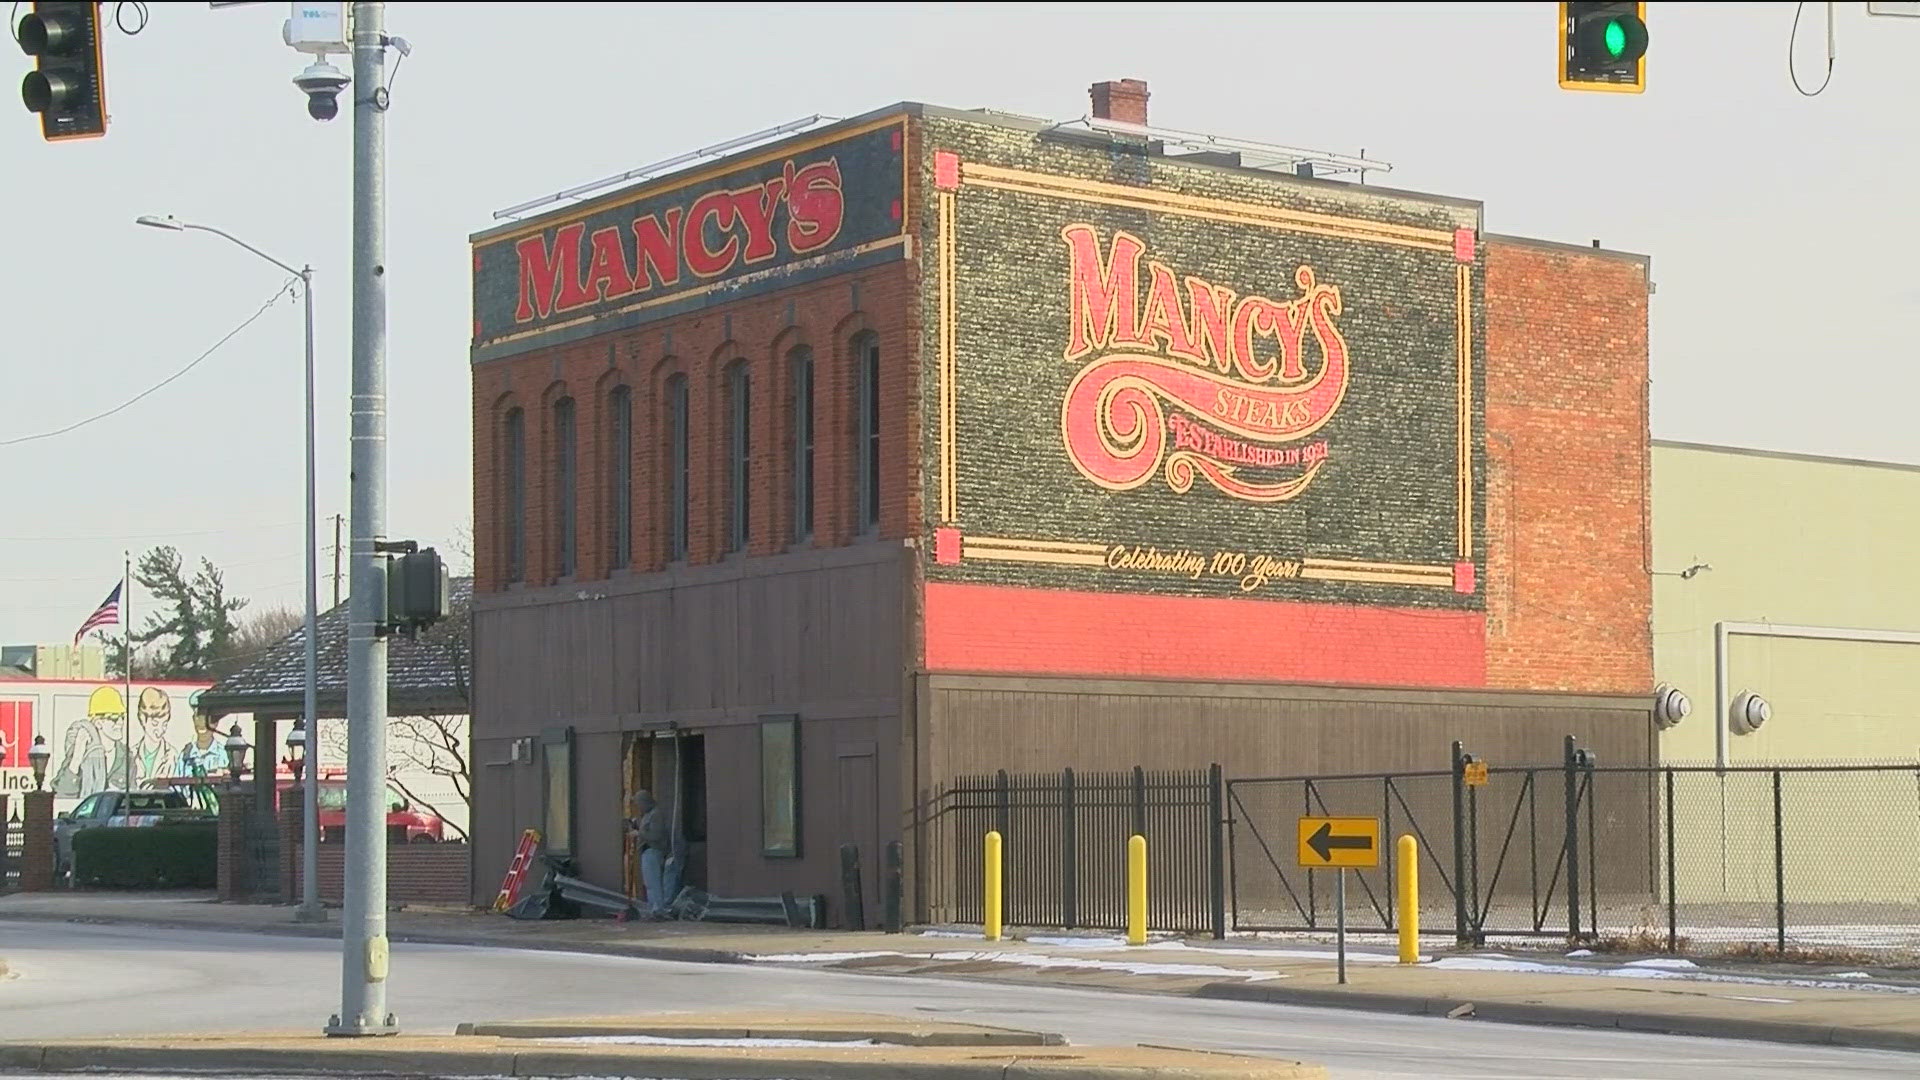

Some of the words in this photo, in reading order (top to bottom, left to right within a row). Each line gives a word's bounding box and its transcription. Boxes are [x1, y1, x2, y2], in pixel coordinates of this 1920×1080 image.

[515, 156, 844, 323] MANCY'S
[1061, 223, 1349, 382] MANCY'S
[1213, 388, 1311, 428] STEAKS
[1168, 413, 1285, 465] ESTABLISHED
[1285, 448, 1300, 464] IN
[1302, 441, 1329, 472] 1921
[1107, 544, 1205, 580] Celebrating
[1209, 551, 1246, 576] 100
[1241, 554, 1301, 592] Years
[2, 769, 34, 790] Inc.
